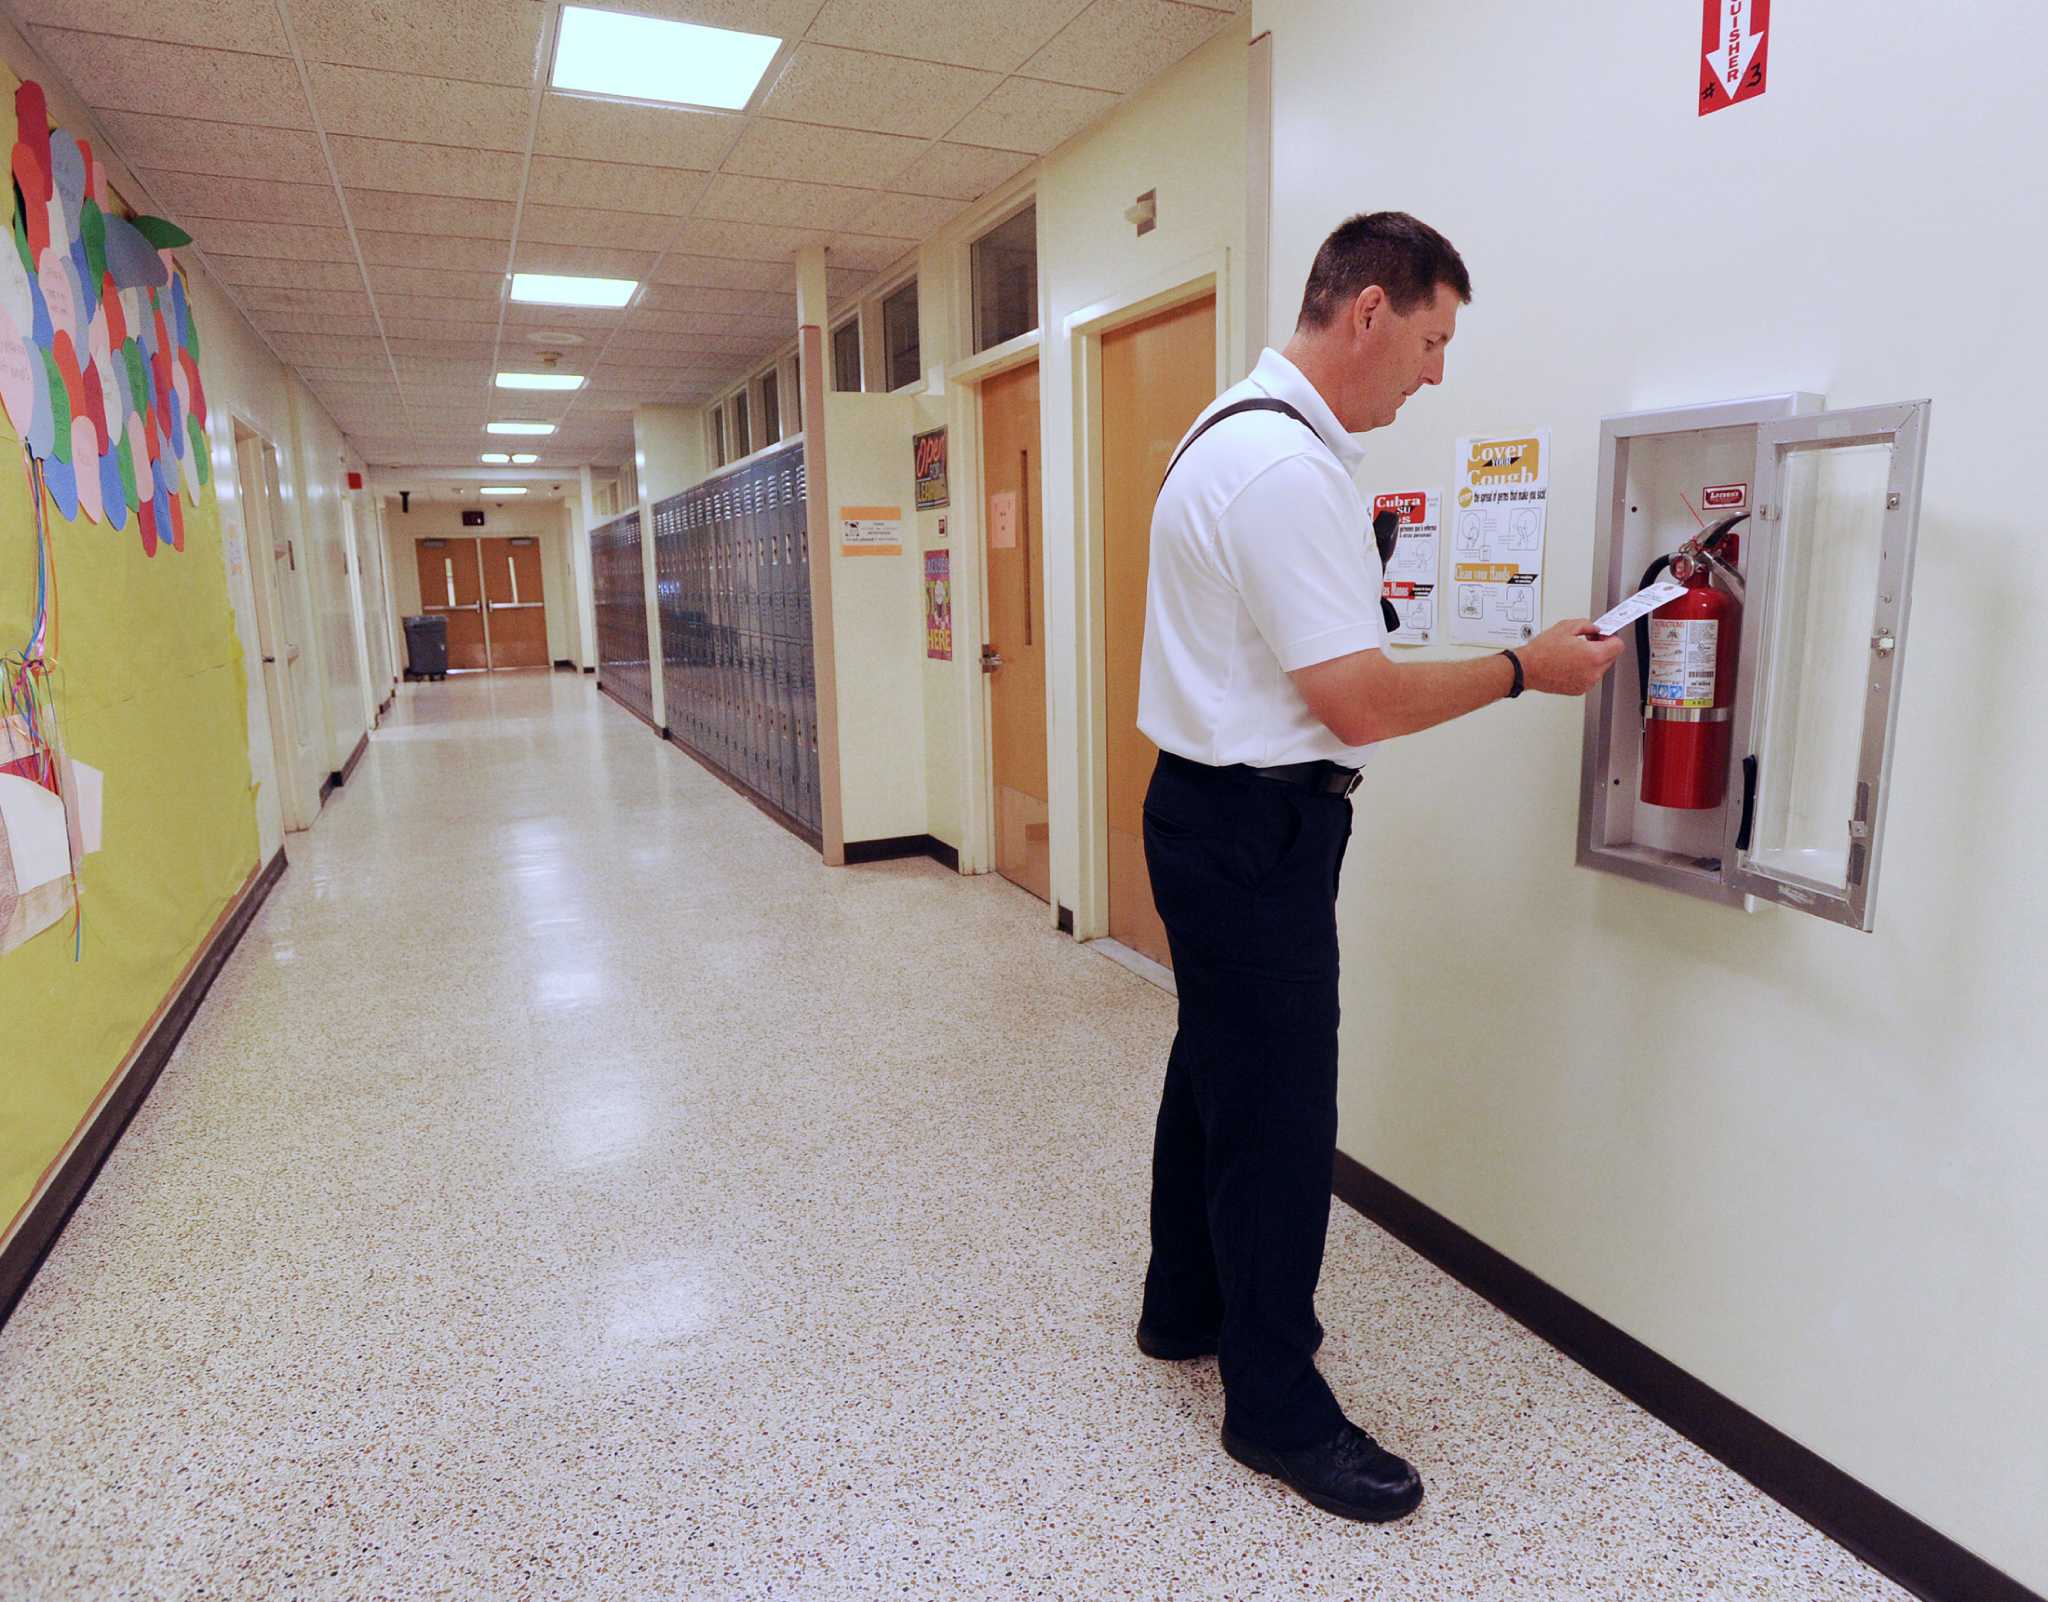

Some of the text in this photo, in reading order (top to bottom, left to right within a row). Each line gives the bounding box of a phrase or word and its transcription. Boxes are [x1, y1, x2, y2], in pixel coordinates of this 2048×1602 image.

[1727, 0, 1742, 82] UISHER
[1746, 62, 1762, 87] 3
[1468, 443, 1528, 463] Cover
[1467, 464, 1535, 486] Cough
[1376, 496, 1421, 508] Cubra
[928, 629, 952, 652] HERE
